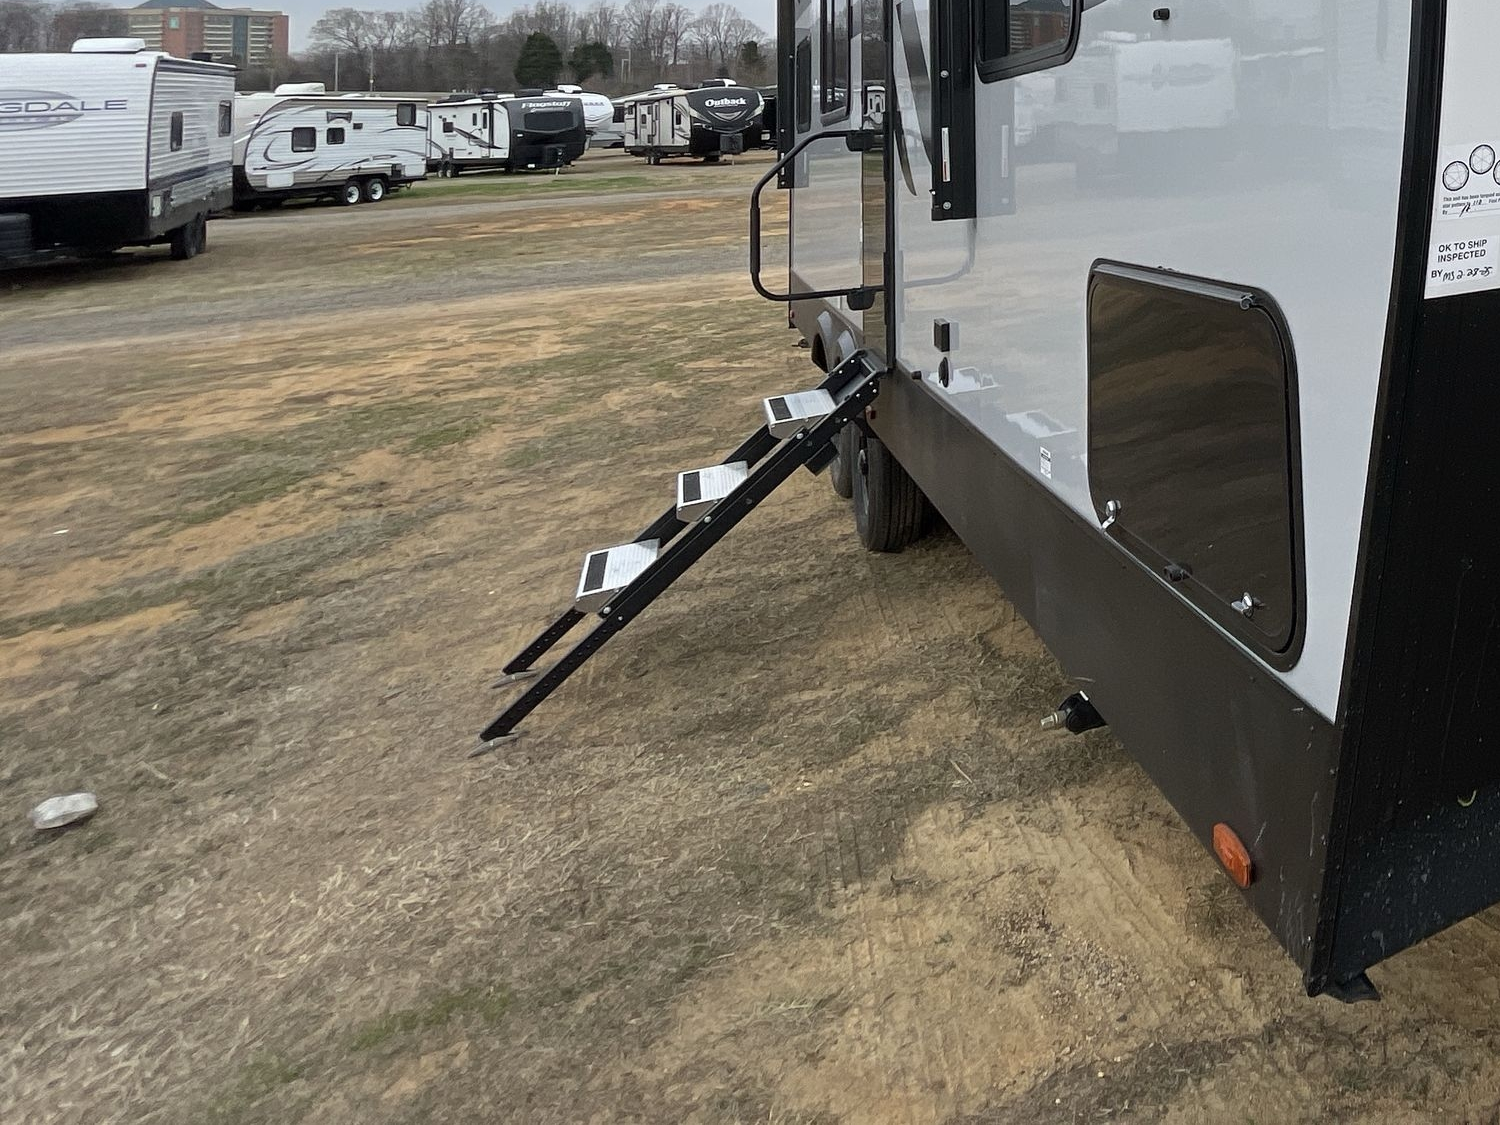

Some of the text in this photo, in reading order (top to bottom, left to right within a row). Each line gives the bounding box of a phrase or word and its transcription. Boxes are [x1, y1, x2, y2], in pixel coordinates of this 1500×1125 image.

[704, 97, 747, 107] Outback
[1438, 238, 1488, 253] OK TO SHIP
[1437, 248, 1487, 263] INSPECTED
[1431, 269, 1443, 279] BY
